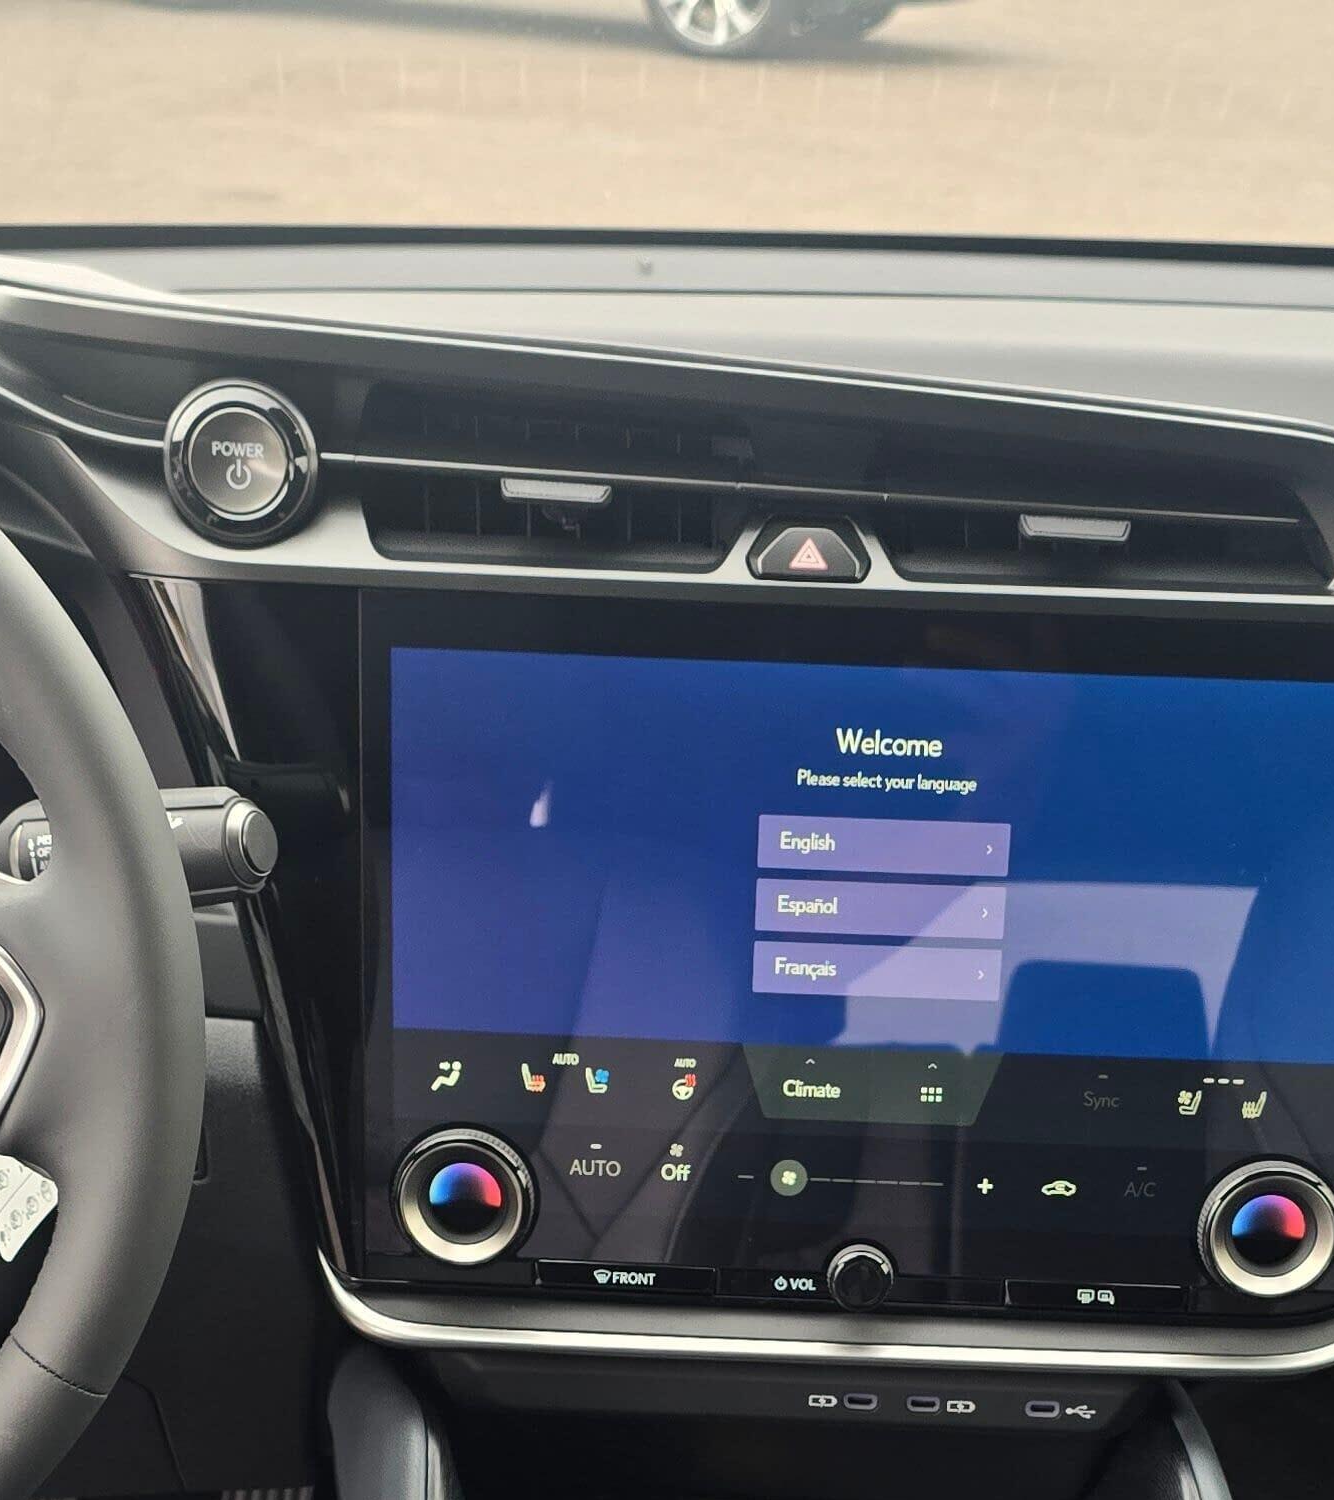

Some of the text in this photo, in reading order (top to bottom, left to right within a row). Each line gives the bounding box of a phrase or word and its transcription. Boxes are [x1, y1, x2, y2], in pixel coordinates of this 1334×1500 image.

[211, 441, 265, 458] POWER
[836, 728, 943, 757] Welcome
[797, 768, 978, 795] Please select your language
[779, 831, 836, 855] English
[777, 895, 838, 917] Español
[774, 956, 837, 981] Français
[552, 1053, 579, 1066] AUTO
[674, 1058, 697, 1069] AUTO
[782, 1079, 842, 1099] Climate
[1083, 1091, 1120, 1111] Sync
[569, 1159, 622, 1177] AUTO
[660, 1163, 692, 1182] Off
[1124, 1181, 1157, 1198] A/C
[612, 1271, 656, 1286] FRONT
[789, 1278, 816, 1291] VOL
